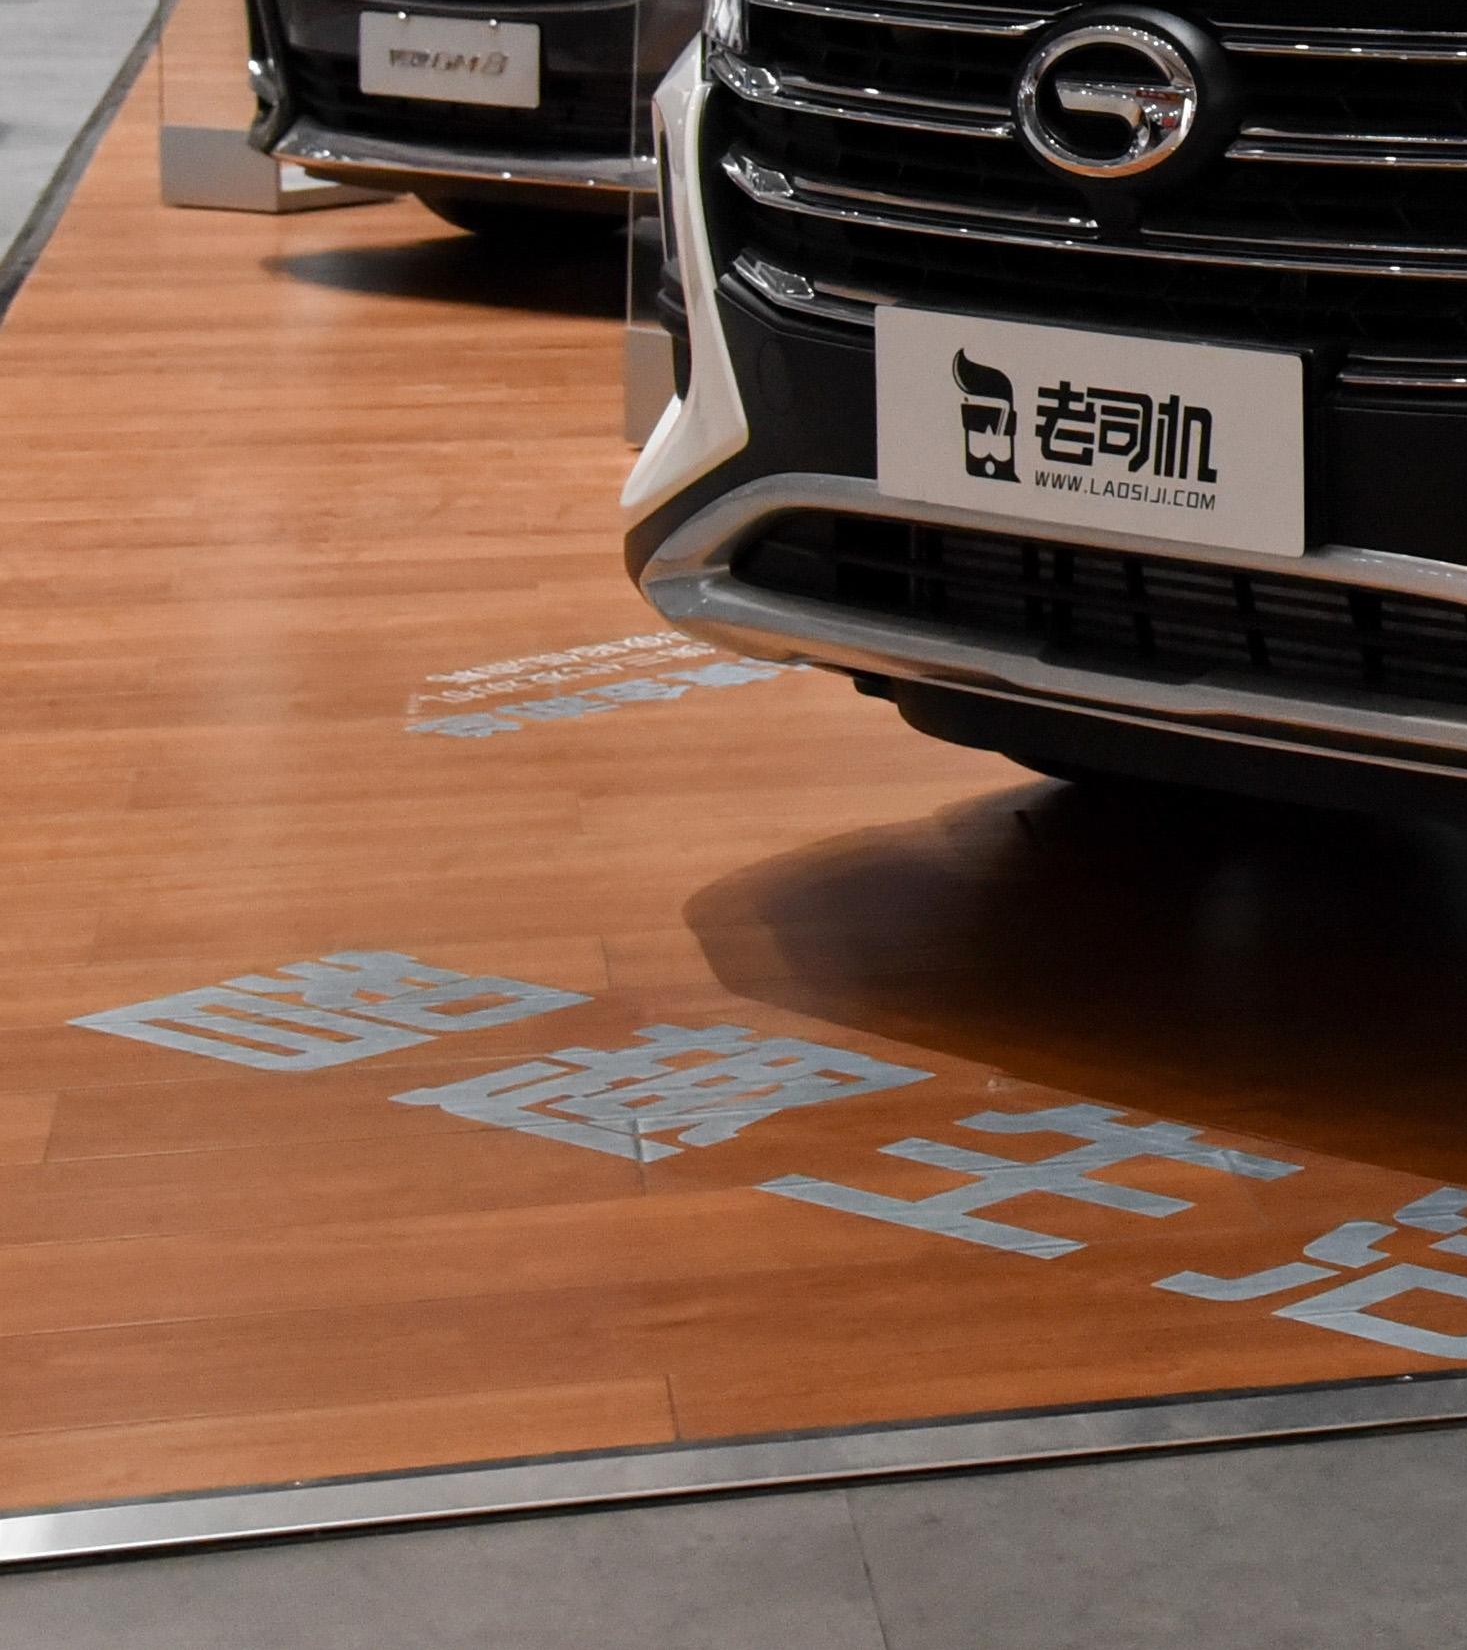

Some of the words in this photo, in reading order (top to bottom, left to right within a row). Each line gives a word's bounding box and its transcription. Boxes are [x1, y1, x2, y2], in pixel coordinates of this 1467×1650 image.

[1034, 380, 1218, 484] 老司机
[1034, 470, 1217, 511] WWW.LAOSIJI.COM
